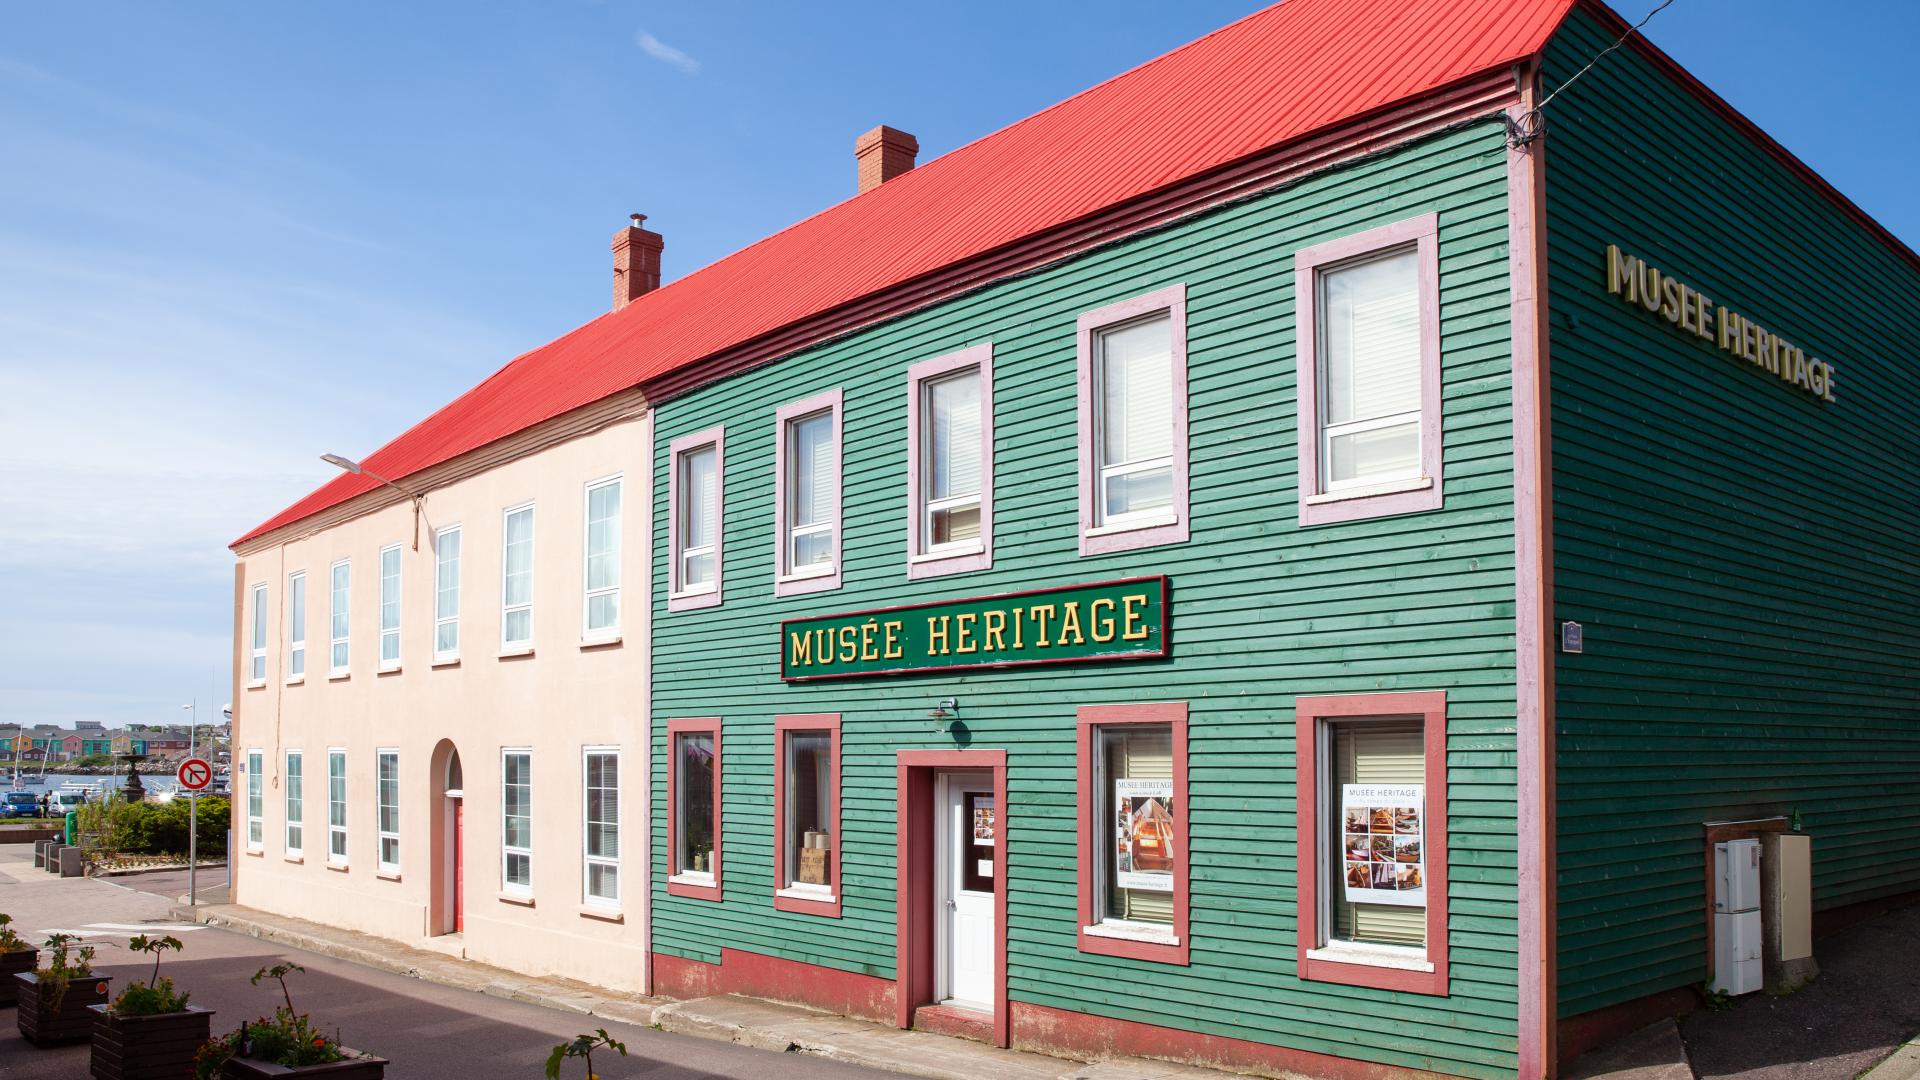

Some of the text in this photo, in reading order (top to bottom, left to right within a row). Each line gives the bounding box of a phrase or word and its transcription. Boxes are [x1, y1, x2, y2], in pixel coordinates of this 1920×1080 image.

[1607, 244, 1836, 402] MUSEE HERITAGE
[927, 594, 1149, 655] HERITAGE
[1377, 789, 1417, 797] HERITAGE
